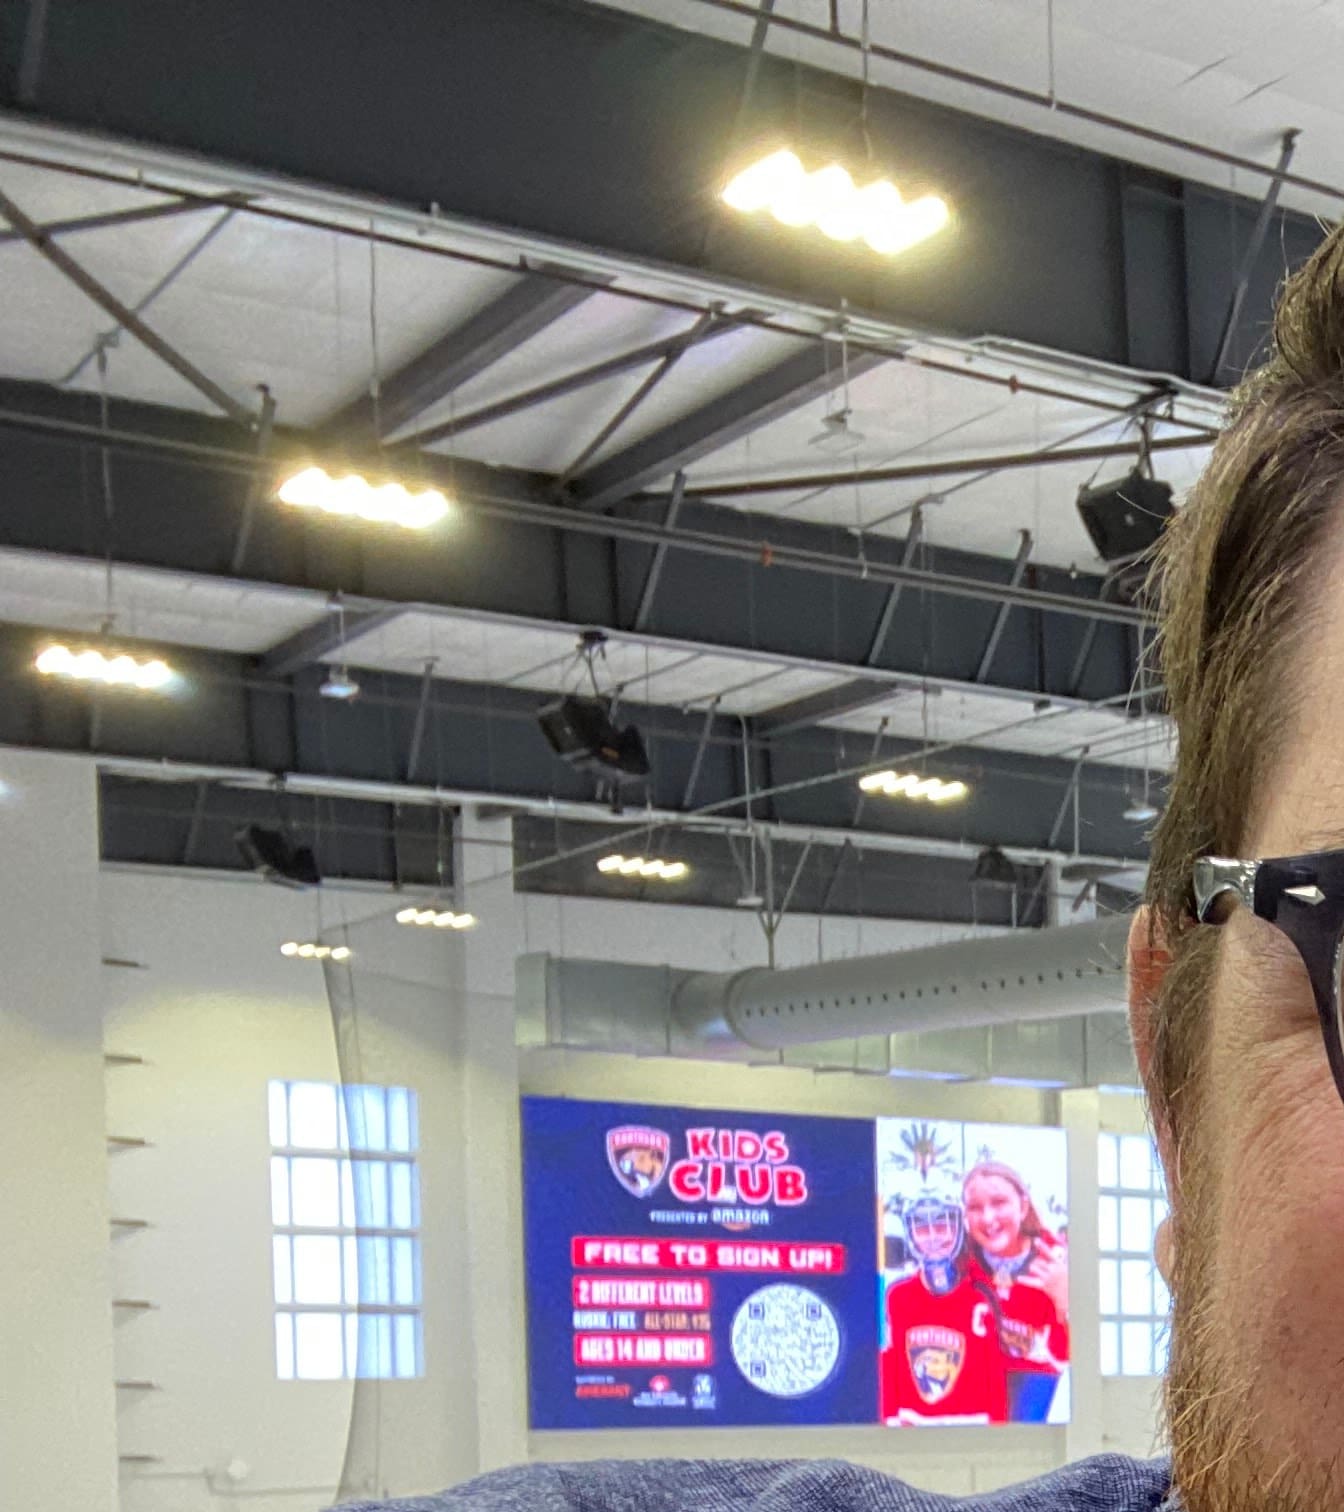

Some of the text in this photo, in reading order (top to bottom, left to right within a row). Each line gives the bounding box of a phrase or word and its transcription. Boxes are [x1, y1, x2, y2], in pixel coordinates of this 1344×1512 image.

[686, 1127, 790, 1164] KIDS
[668, 1158, 808, 1206] CLUB
[711, 1207, 771, 1225] amazon
[584, 1241, 833, 1270] FREE TO SIGN UP!
[579, 1280, 704, 1307] 2 DIFFERENT LEVELS
[581, 1337, 706, 1362] AGES 14 AND UNDER
